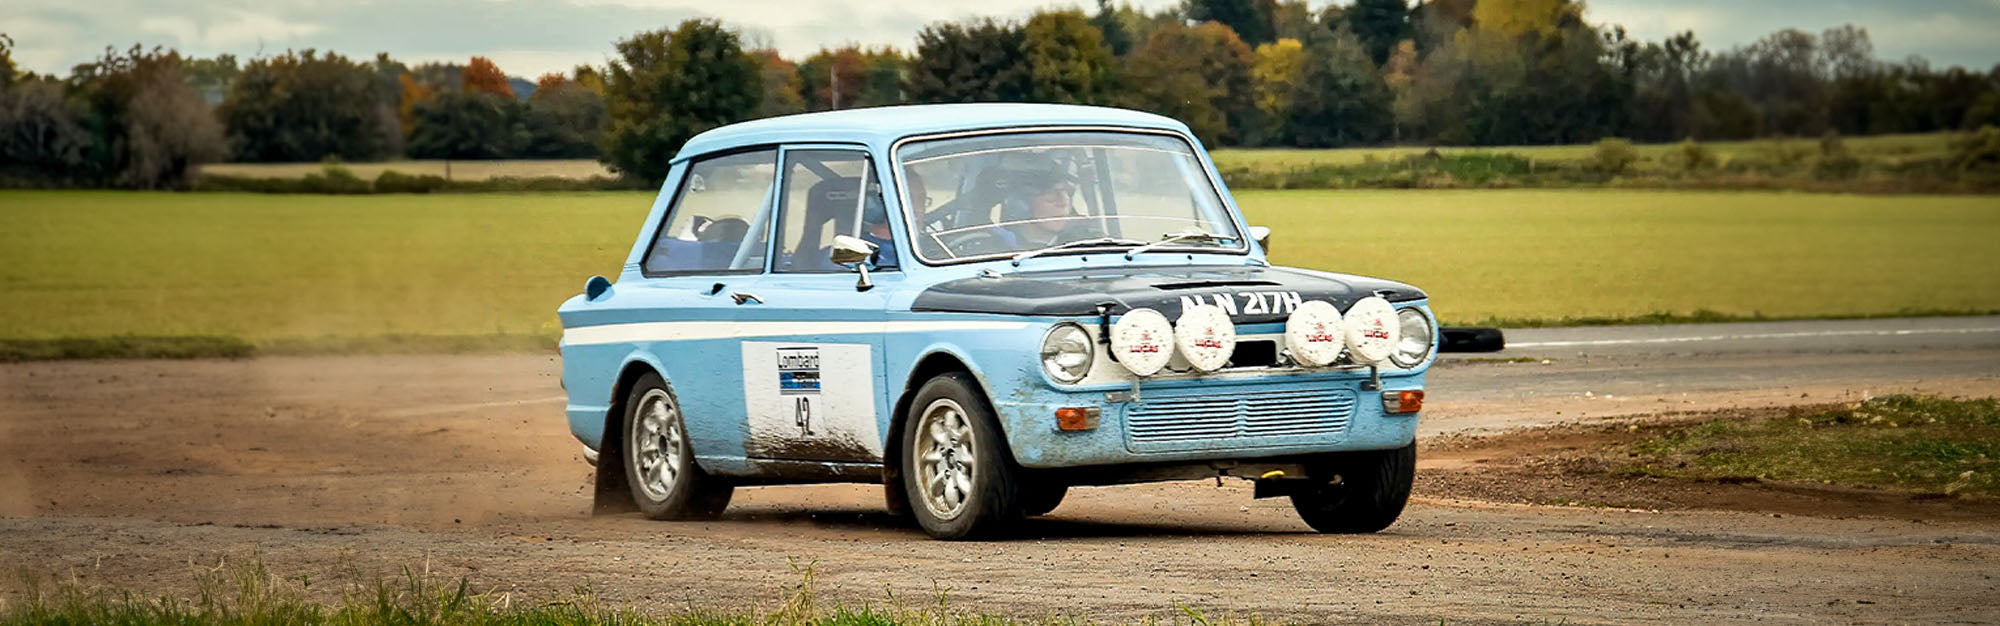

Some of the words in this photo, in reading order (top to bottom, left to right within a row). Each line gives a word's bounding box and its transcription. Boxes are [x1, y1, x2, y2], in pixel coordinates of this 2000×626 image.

[1238, 291, 1302, 315] 217H
[1130, 345, 1159, 353] LUCAS
[776, 351, 820, 368] Lombard
[796, 397, 815, 436] 42
